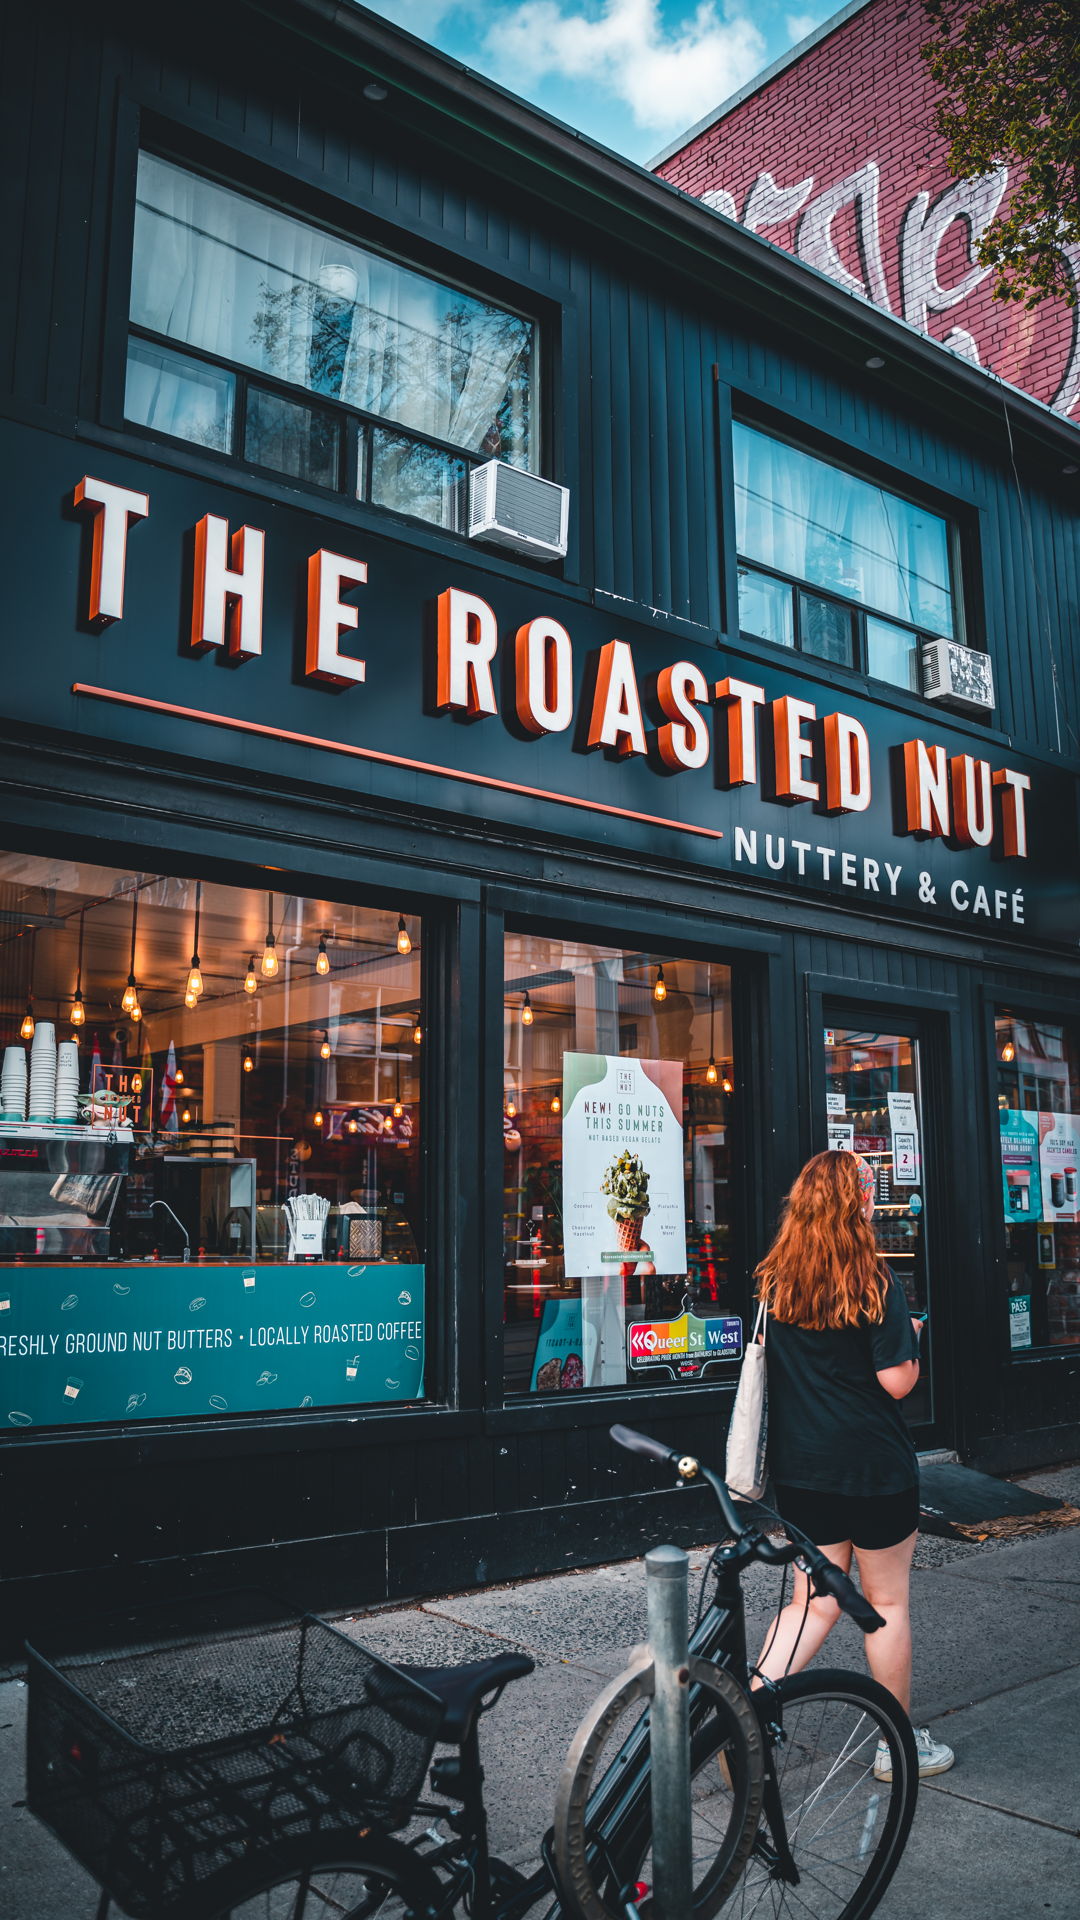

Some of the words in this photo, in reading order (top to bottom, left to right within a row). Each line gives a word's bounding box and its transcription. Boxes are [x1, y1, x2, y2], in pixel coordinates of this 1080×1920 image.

[73, 474, 369, 689] THE
[436, 586, 872, 818] ROASTED
[905, 737, 1032, 859] NUT
[733, 826, 904, 897] NUTTERY
[917, 873, 938, 905] &
[950, 879, 1027, 925] CAFÉ
[620, 1083, 632, 1092] NUT
[103, 1103, 142, 1124] NUT
[584, 1101, 612, 1114] NEW!
[618, 1103, 631, 1116] GO
[637, 1104, 664, 1117] NUTS
[586, 1117, 612, 1130] THIS
[618, 1118, 663, 1133] SUMMER
[902, 1154, 908, 1164] 2
[1011, 1300, 1027, 1313] PASS
[65, 1332, 128, 1355] GROUND
[133, 1331, 162, 1351] NUT
[167, 1328, 233, 1350] BUTTERS
[250, 1325, 309, 1347] LOCALLY
[314, 1322, 373, 1344] ROASTED
[377, 1320, 422, 1341] COFFEE
[643, 1330, 688, 1352] Queer
[689, 1331, 706, 1347] St.
[708, 1330, 739, 1345] West
